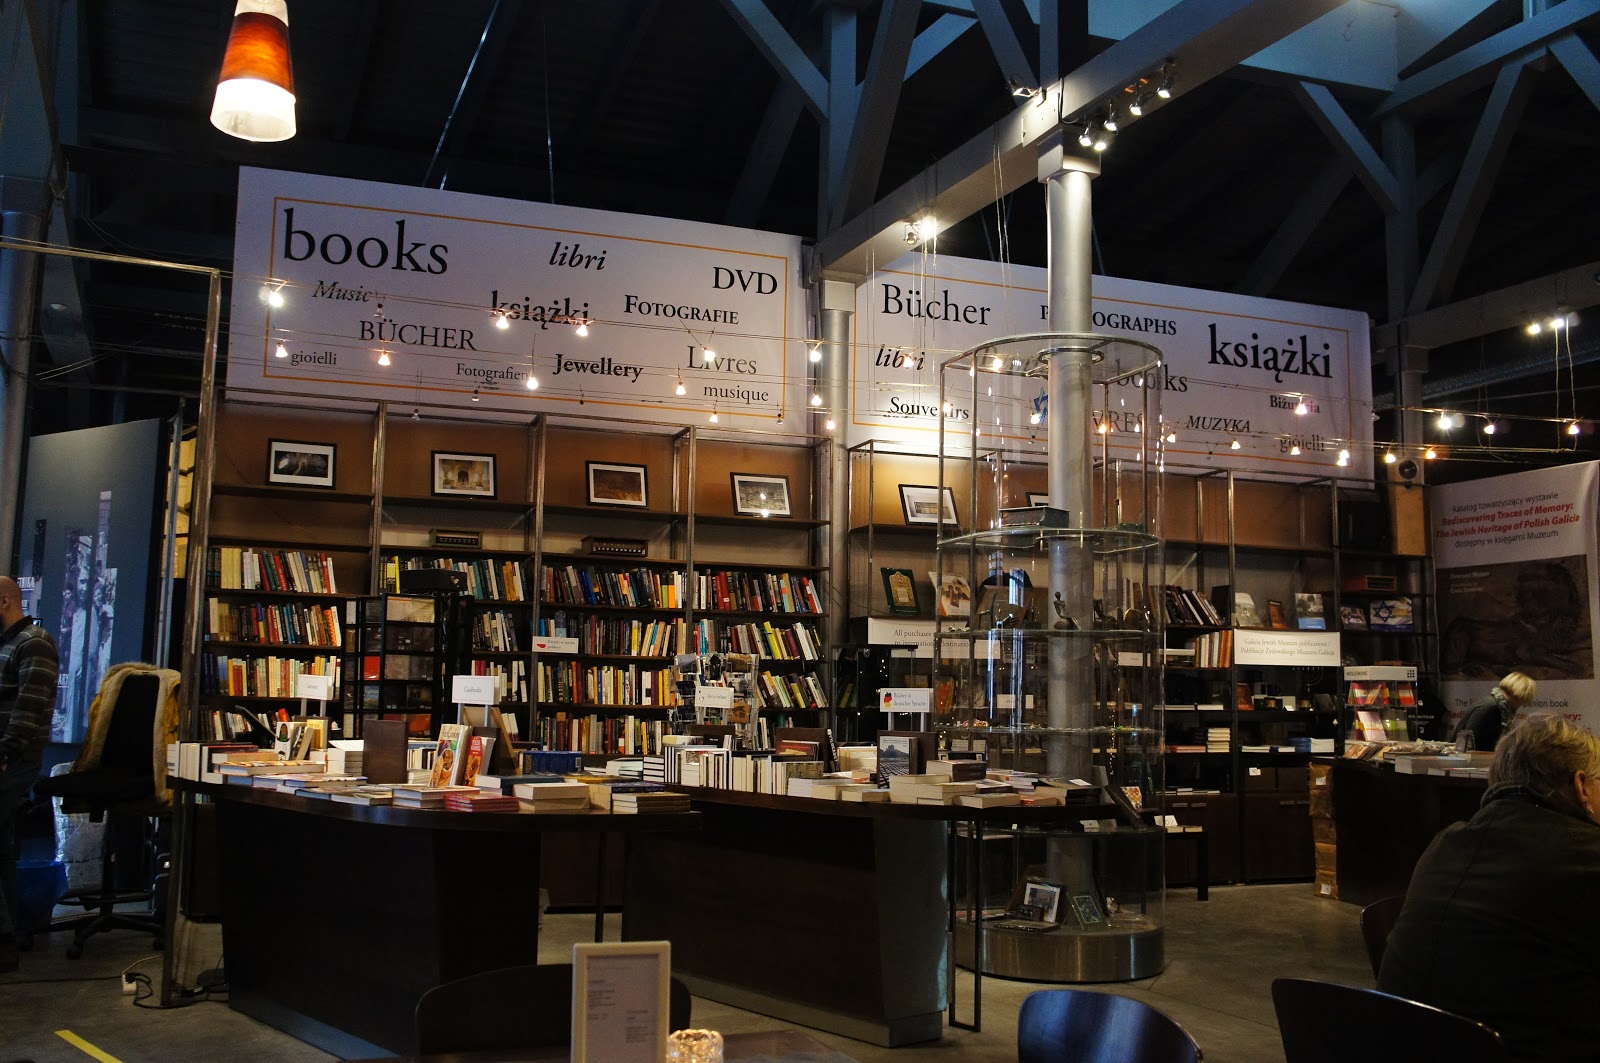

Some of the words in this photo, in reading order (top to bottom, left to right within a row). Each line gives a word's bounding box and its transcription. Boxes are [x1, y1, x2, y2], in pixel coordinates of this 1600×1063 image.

[284, 208, 448, 274] books
[549, 242, 606, 271] libri
[312, 280, 371, 302] Music
[712, 266, 778, 294] DVD
[490, 290, 590, 330] książki
[882, 284, 991, 326] Bücher
[1040, 304, 1177, 335] POGRAPHS
[359, 318, 477, 350] BÜCHER
[291, 350, 337, 366] gioielli
[1208, 323, 1332, 383] książki
[456, 362, 528, 382] Fotografien
[553, 353, 644, 382] Jewellery
[704, 386, 769, 404] musique
[1270, 395, 1320, 413] Biżuia
[1186, 416, 1251, 432] MUZYKA
[1280, 434, 1324, 453] gioielli
[1452, 504, 1477, 512] Katalog
[1526, 492, 1558, 502] wystawie
[1442, 514, 1496, 526] Rediscovering
[1498, 508, 1522, 518] Traces
[1524, 506, 1534, 516] of
[1534, 502, 1574, 514] Memory:
[1436, 530, 1450, 538] The
[1450, 526, 1476, 537] Jewish
[1478, 523, 1512, 534] Heritage
[1514, 520, 1522, 530] of
[1524, 518, 1550, 528] Polish
[1552, 514, 1580, 526] Galicia
[1527, 530, 1558, 540] Muzeum
[904, 630, 932, 638] purchases
[1550, 699, 1569, 708] book
